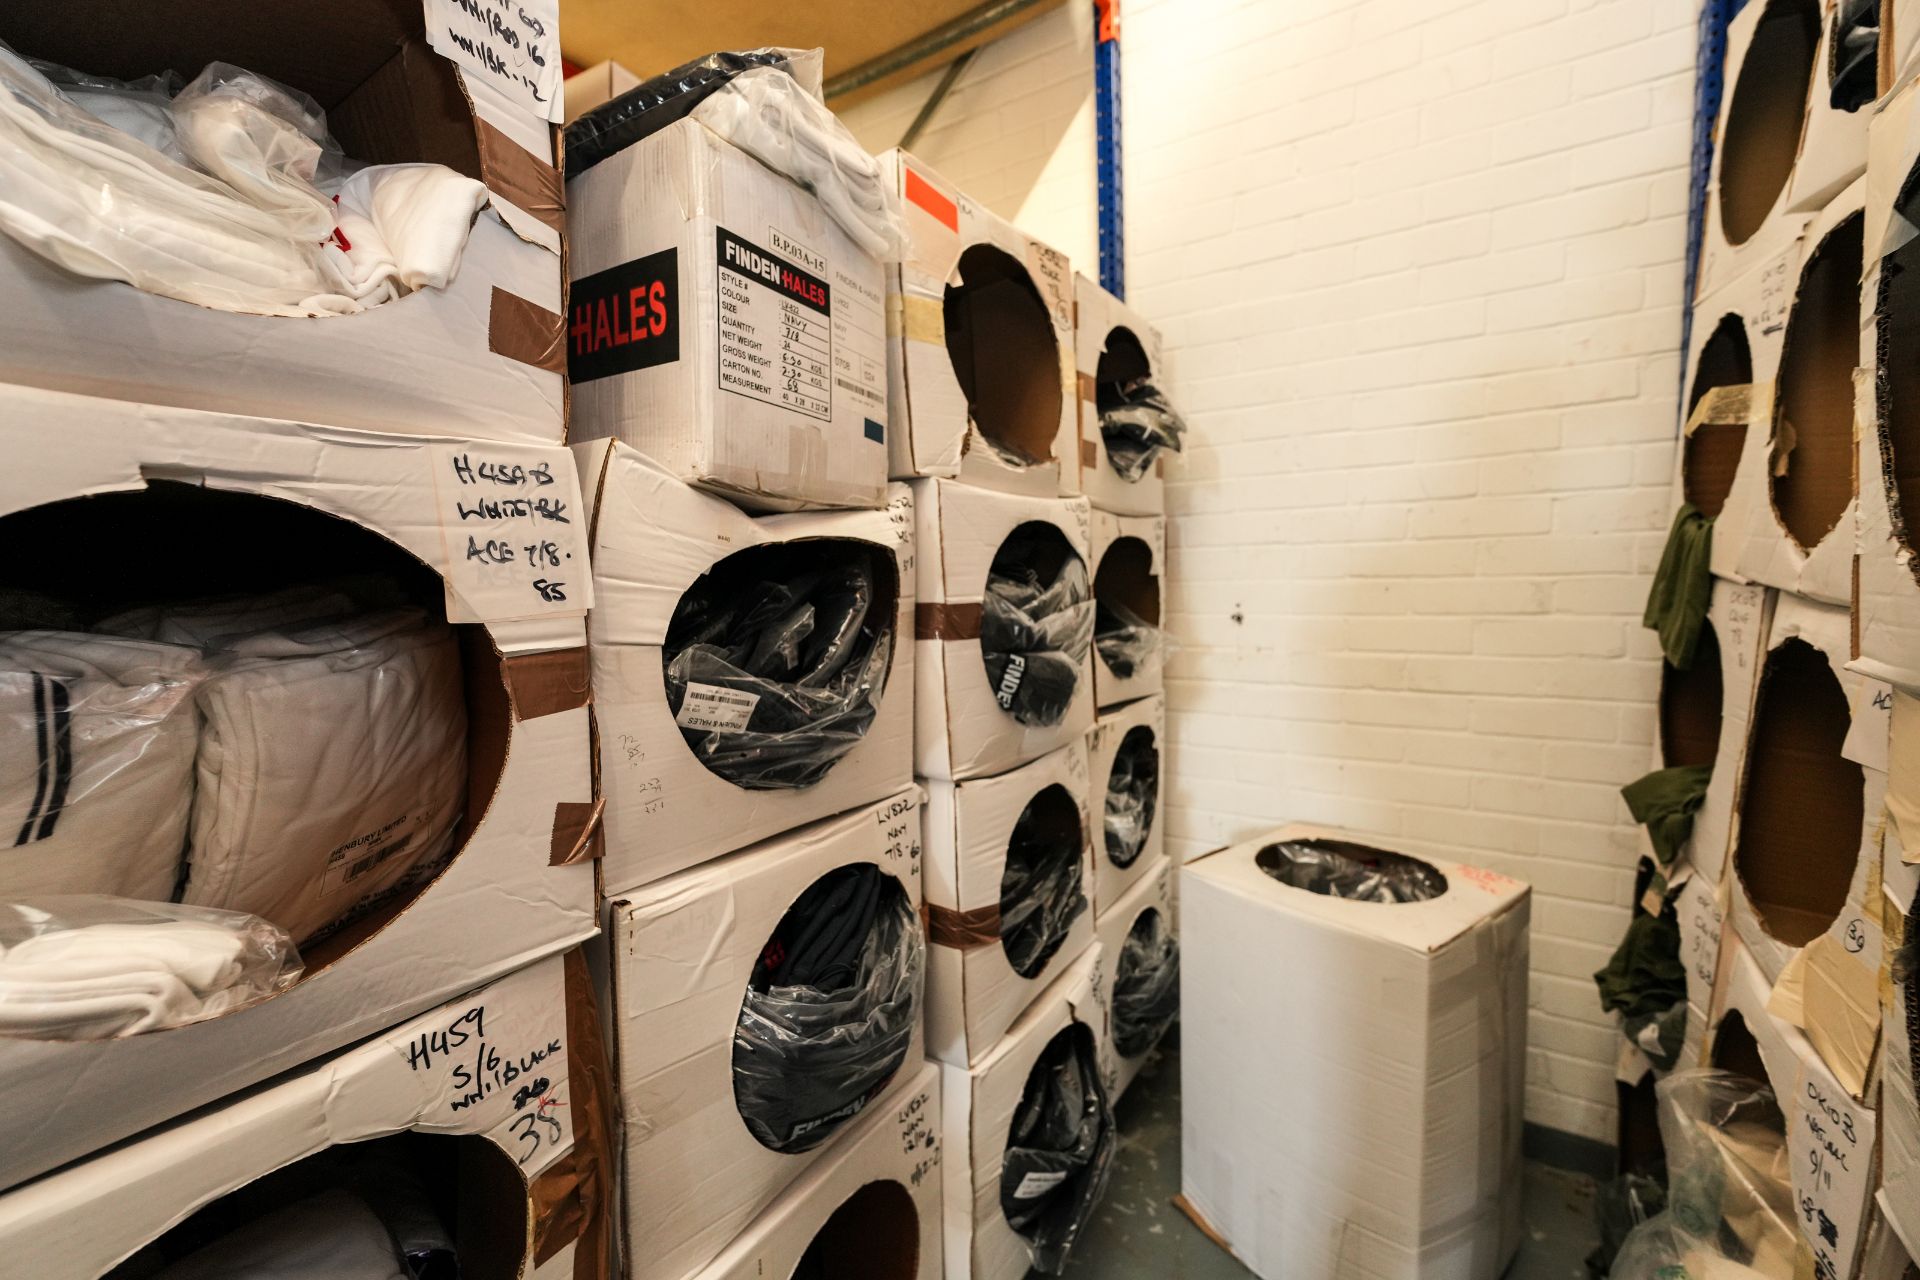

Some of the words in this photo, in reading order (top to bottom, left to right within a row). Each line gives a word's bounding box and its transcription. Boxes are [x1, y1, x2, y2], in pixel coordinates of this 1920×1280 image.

[773, 233, 825, 273] B.P.03A-15
[721, 271, 743, 289] STYLE
[725, 238, 781, 286] FINDEN
[781, 270, 826, 307] HALES
[570, 280, 668, 357] HALES
[721, 300, 737, 314] SIZE
[721, 286, 750, 306] COLOUR
[784, 312, 808, 333] NAVY
[721, 314, 756, 336] QUANTITY
[722, 329, 736, 343] NET
[737, 335, 762, 352] WEIGHT
[722, 343, 747, 360] GROSS
[747, 352, 772, 369] WEIGHT
[722, 358, 751, 375] CARTON
[722, 372, 772, 396] MEASUREMENT
[532, 578, 567, 602] 85
[996, 653, 1025, 709] FINDE
[687, 717, 712, 726] HALES
[377, 815, 407, 838] LIMITED
[408, 1006, 484, 1070] H459
